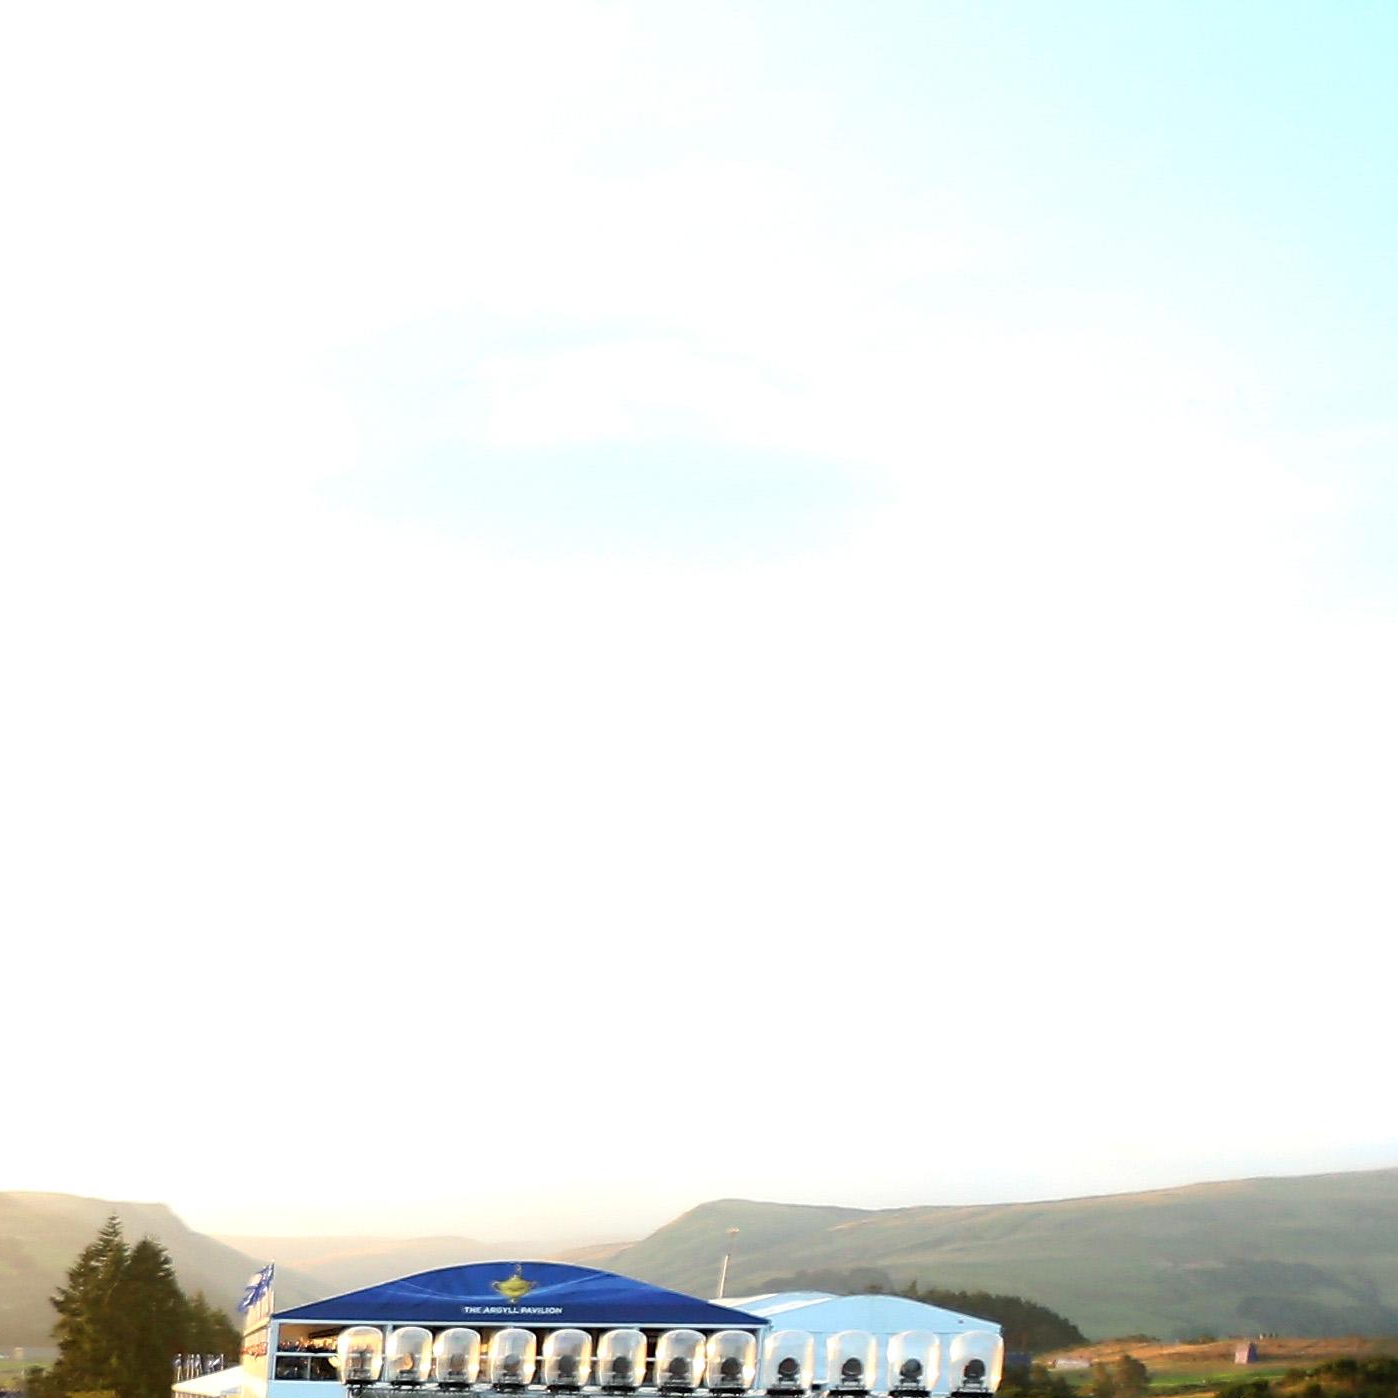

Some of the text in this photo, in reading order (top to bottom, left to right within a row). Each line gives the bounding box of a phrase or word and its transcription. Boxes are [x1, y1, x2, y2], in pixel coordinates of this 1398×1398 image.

[464, 1306, 563, 1314] THE ARGYLL PAVILION
